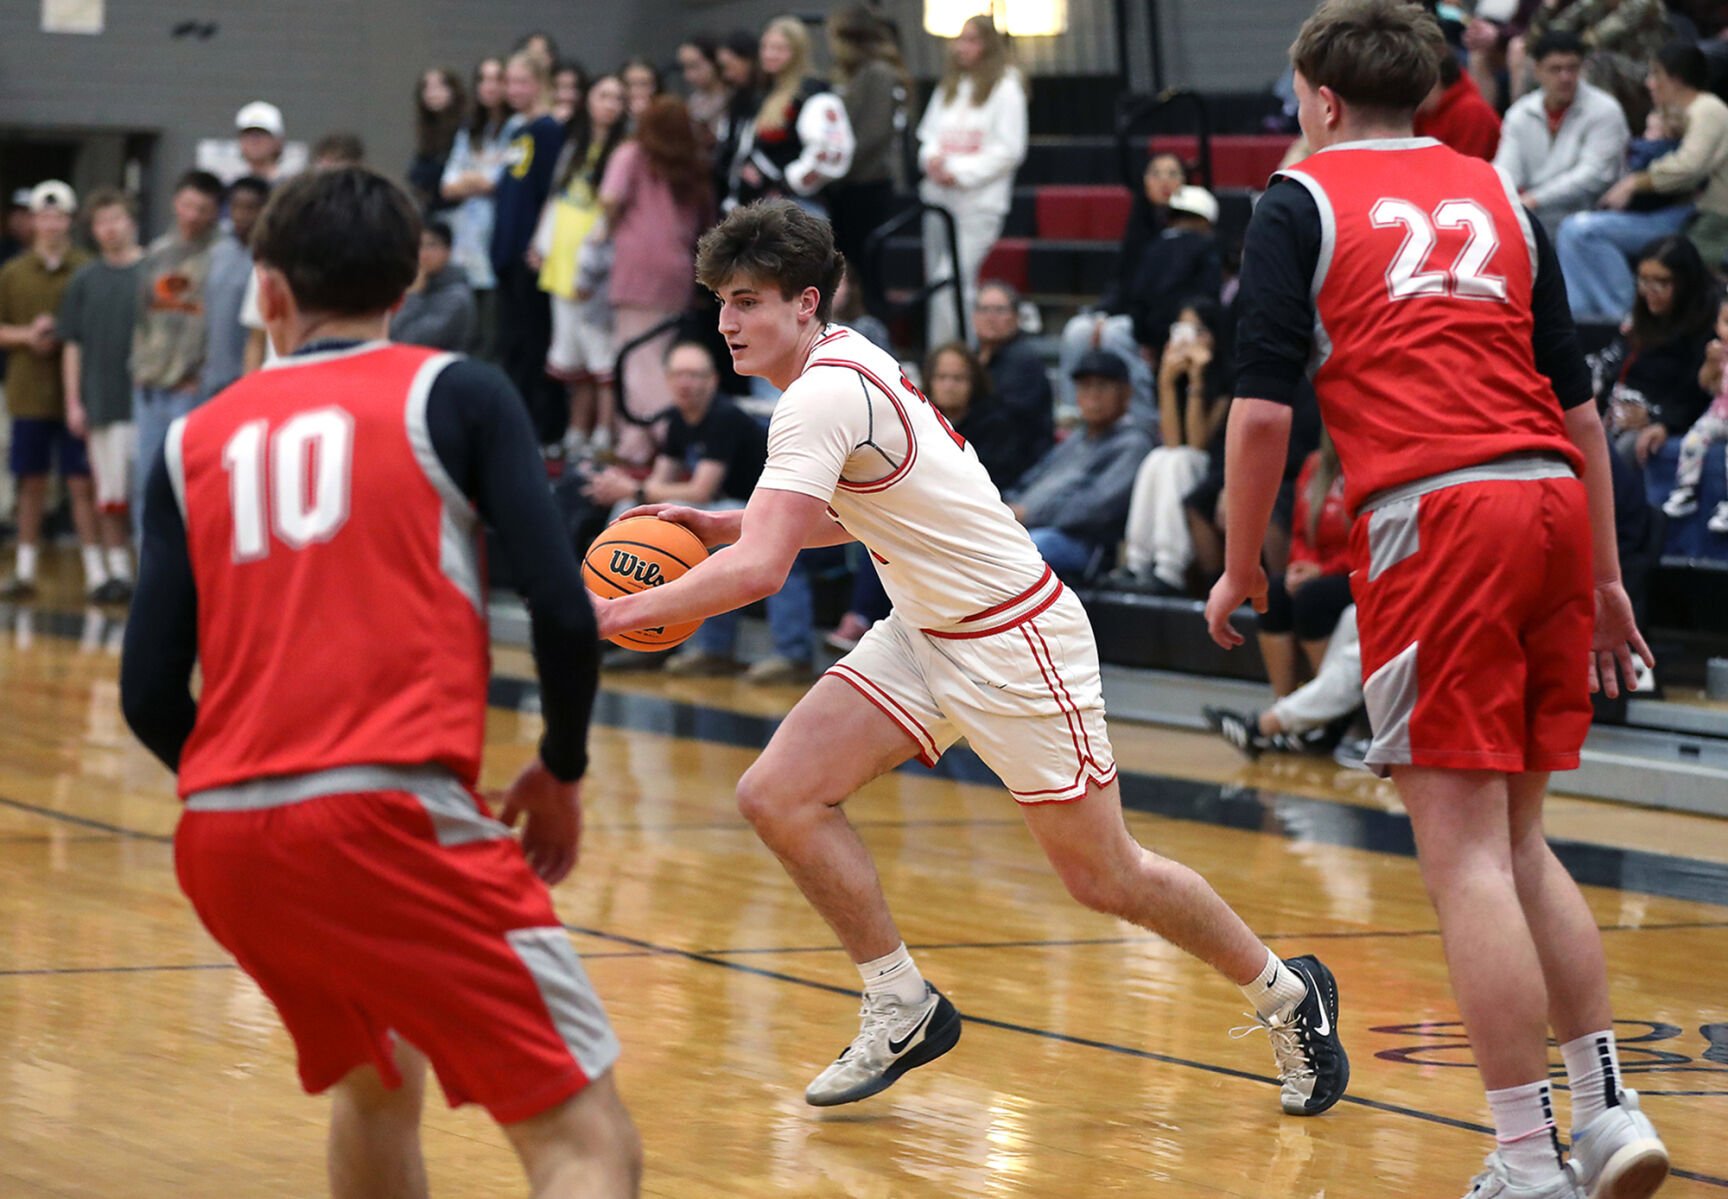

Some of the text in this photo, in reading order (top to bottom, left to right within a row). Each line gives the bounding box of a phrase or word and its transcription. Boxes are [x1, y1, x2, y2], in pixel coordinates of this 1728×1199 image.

[1369, 198, 1508, 302] 22
[222, 404, 355, 564] 10
[609, 549, 668, 588] Wils
